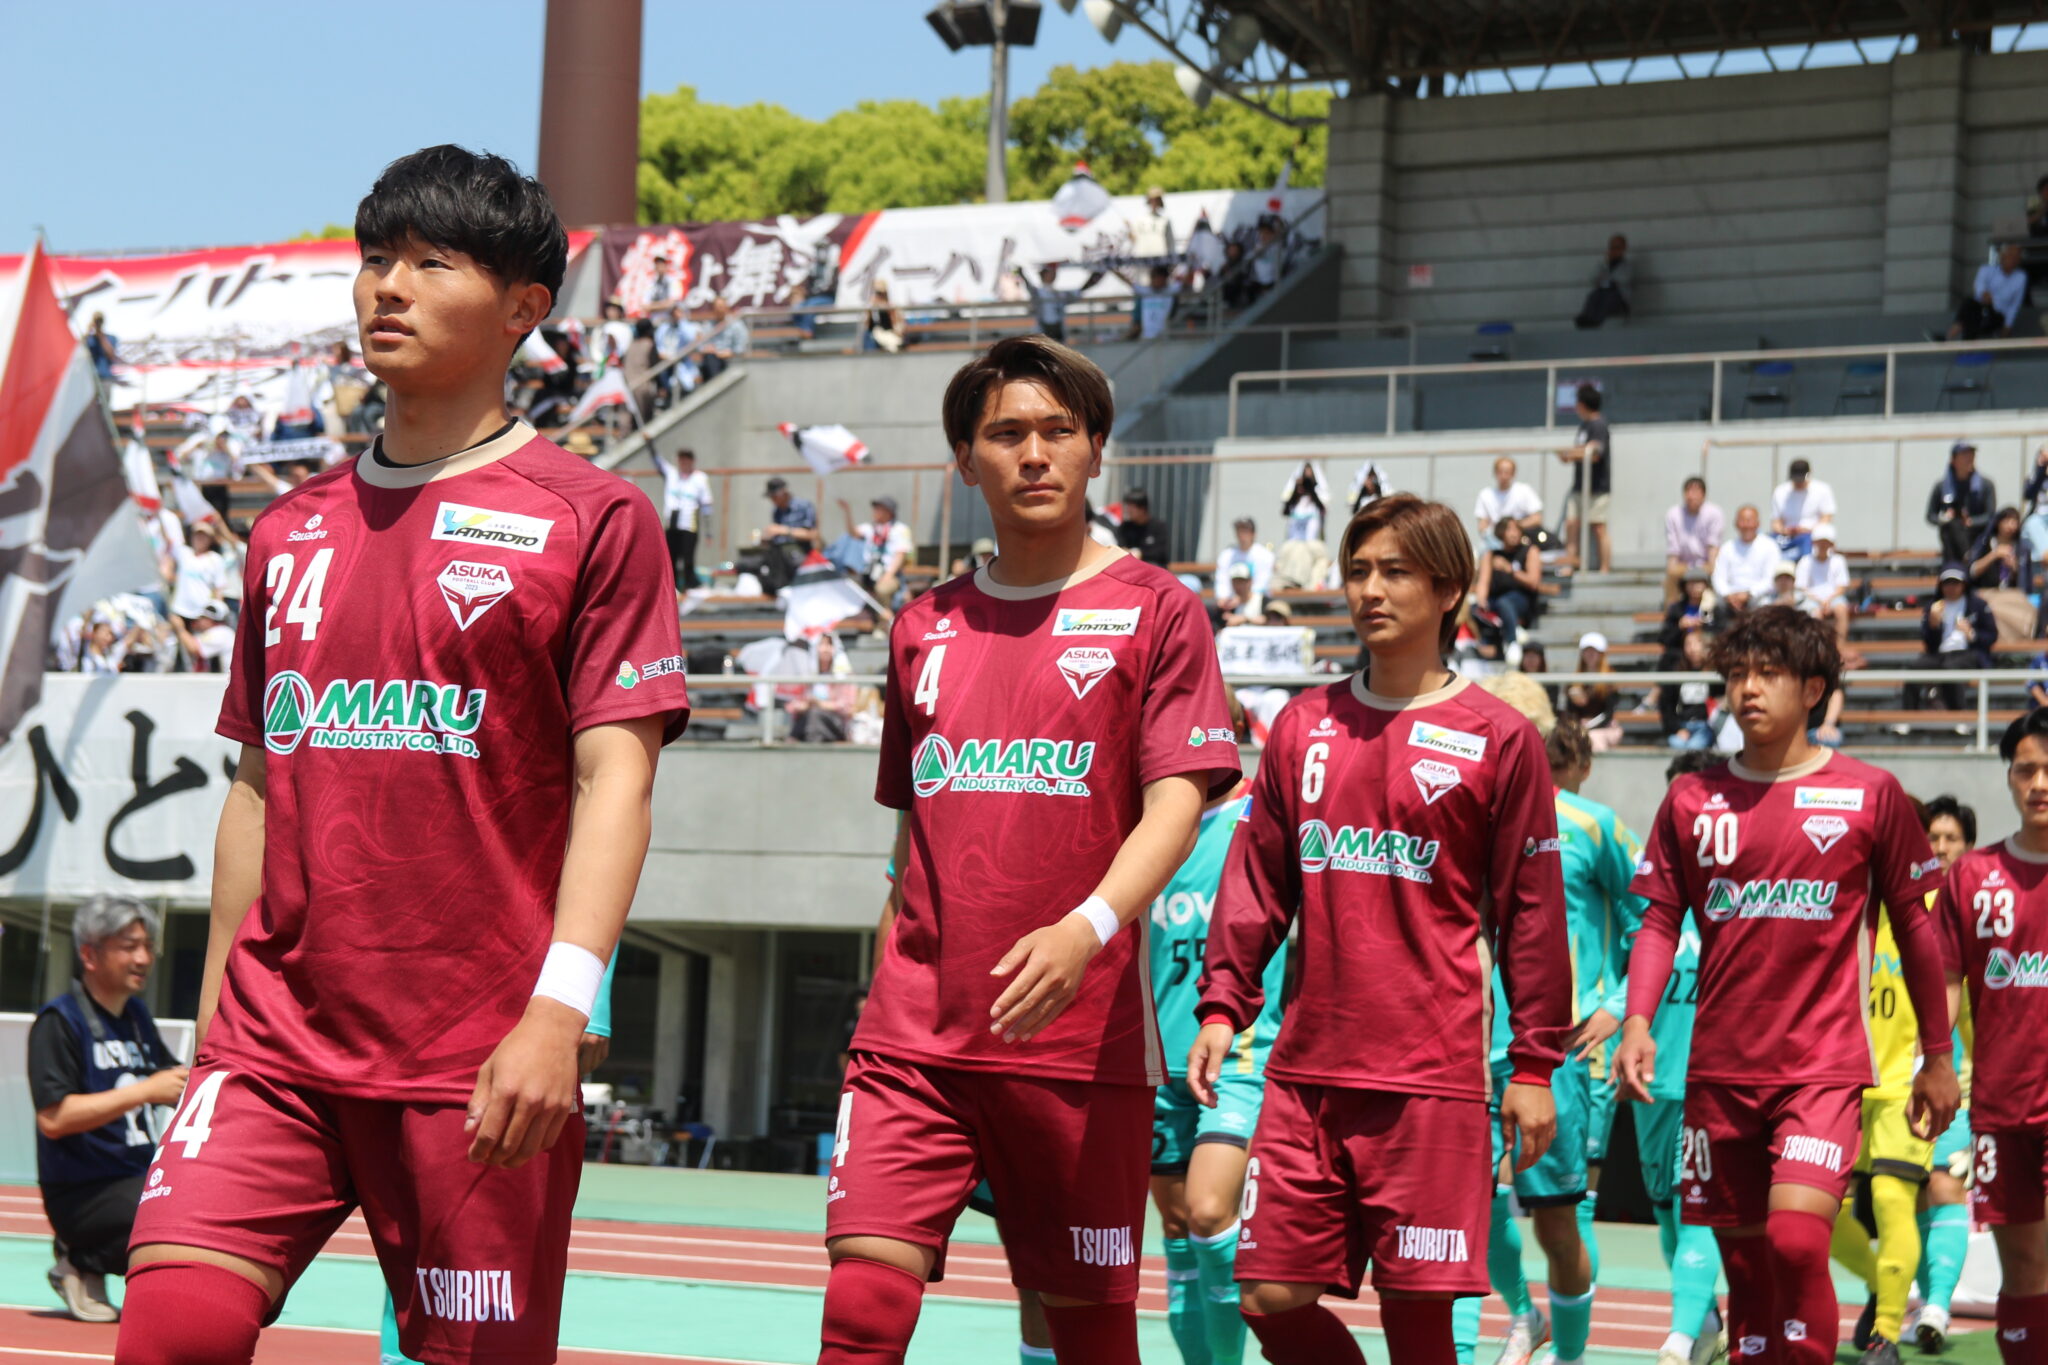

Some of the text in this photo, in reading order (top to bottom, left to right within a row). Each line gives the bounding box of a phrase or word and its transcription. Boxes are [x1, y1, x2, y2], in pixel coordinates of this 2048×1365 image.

[447, 564, 505, 582] ASUKA
[265, 548, 335, 648] 24
[1064, 650, 1109, 660] ASUKA
[915, 645, 947, 716] 4
[312, 682, 485, 733] MARU
[312, 730, 405, 748] INDUSTRY
[444, 736, 480, 757] LTD.
[953, 741, 1093, 777] MARU
[952, 779, 1025, 790] INDUSTRY
[1301, 742, 1330, 804] 6
[1418, 762, 1456, 777] ASUKA
[1331, 828, 1438, 868] MARU
[1693, 812, 1739, 867] 20
[1740, 880, 1836, 907] MARU
[1973, 888, 2015, 939] 23
[832, 1091, 854, 1168] 4
[1682, 1126, 1712, 1182] 20
[1781, 1135, 1843, 1173] TSURUTA
[1972, 1133, 1997, 1184] 3
[1239, 1157, 1260, 1221] 6
[1069, 1226, 1134, 1267] TSURU
[1395, 1225, 1469, 1263] TSURUTA
[417, 1267, 515, 1322] TSURUTA
